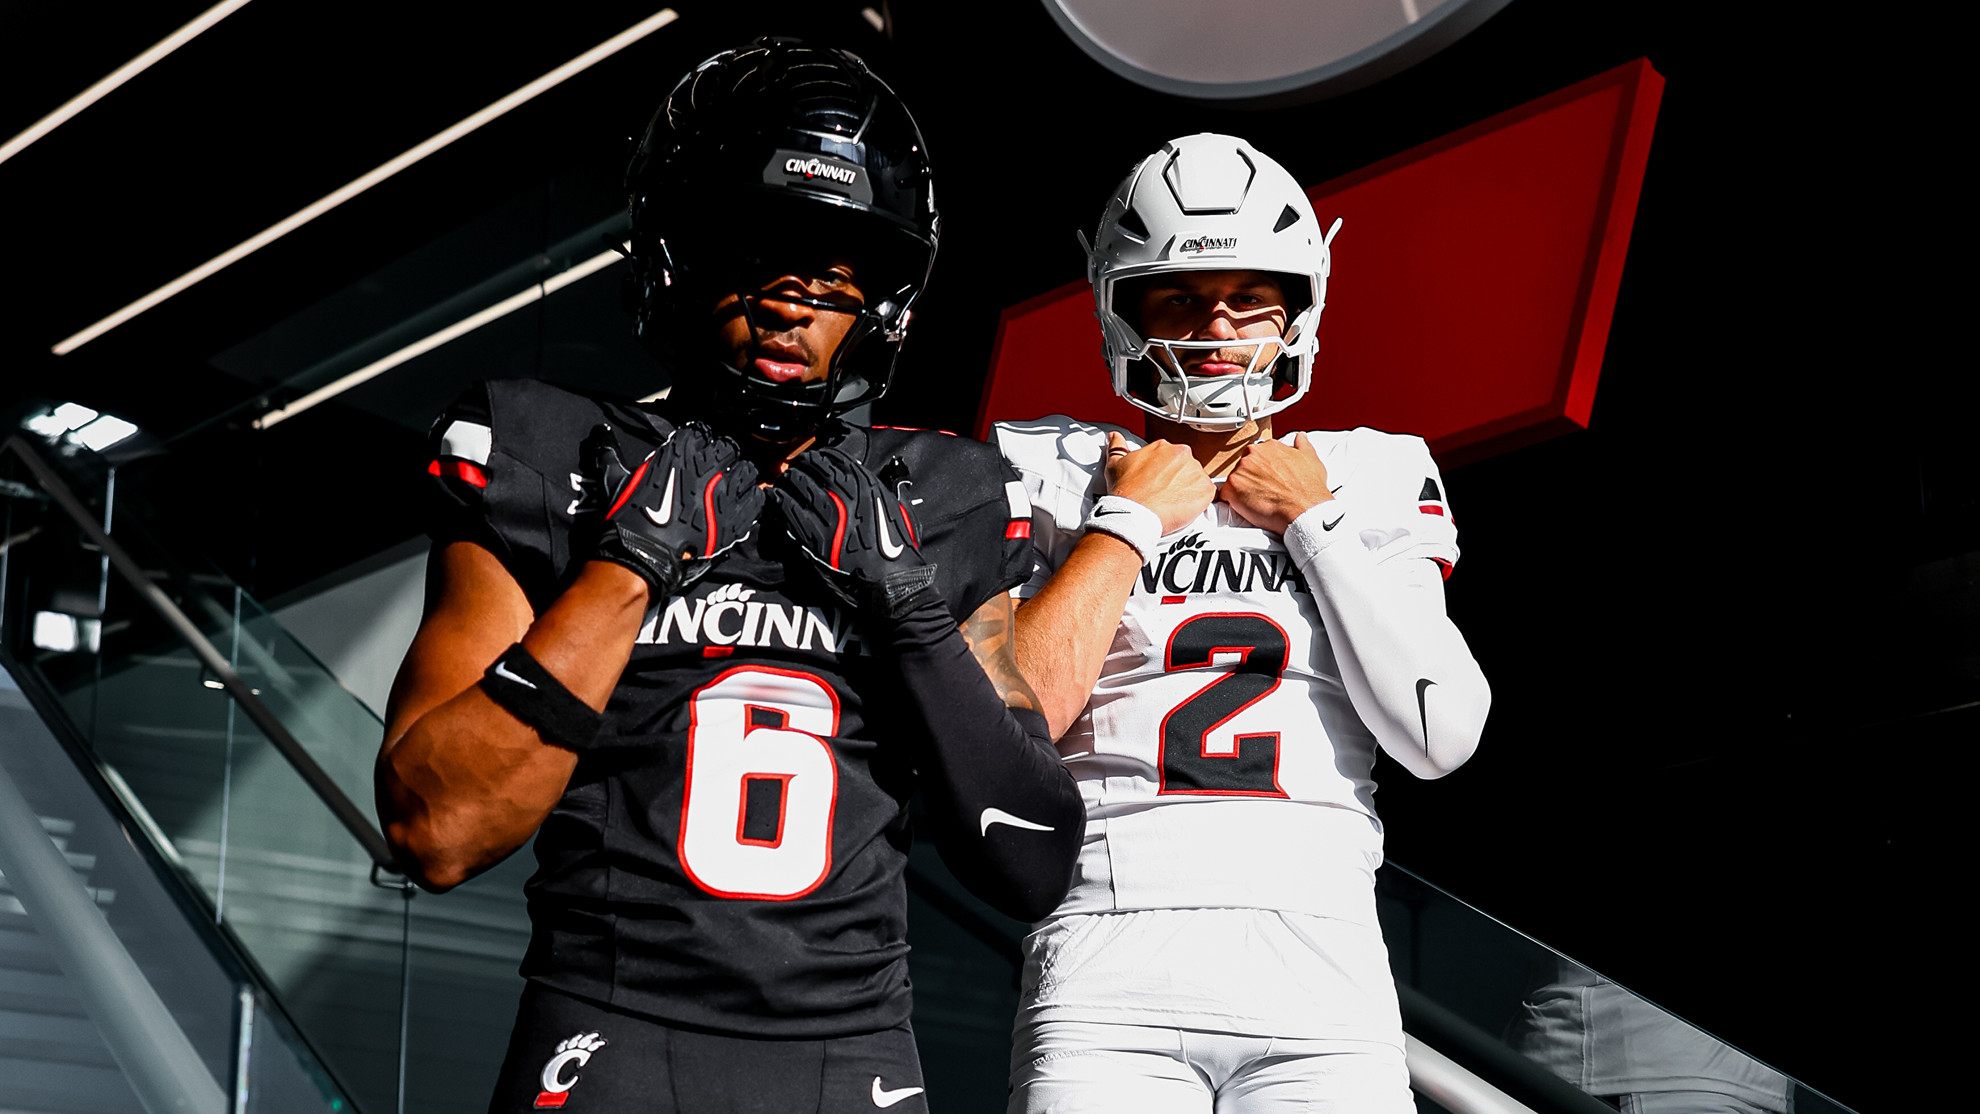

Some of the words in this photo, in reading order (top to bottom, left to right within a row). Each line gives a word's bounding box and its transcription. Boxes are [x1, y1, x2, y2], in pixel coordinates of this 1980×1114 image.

[785, 158, 857, 184] CINCINNATI
[1183, 235, 1238, 251] CINCINNATI
[1156, 612, 1291, 800] 2
[677, 664, 841, 902] 6
